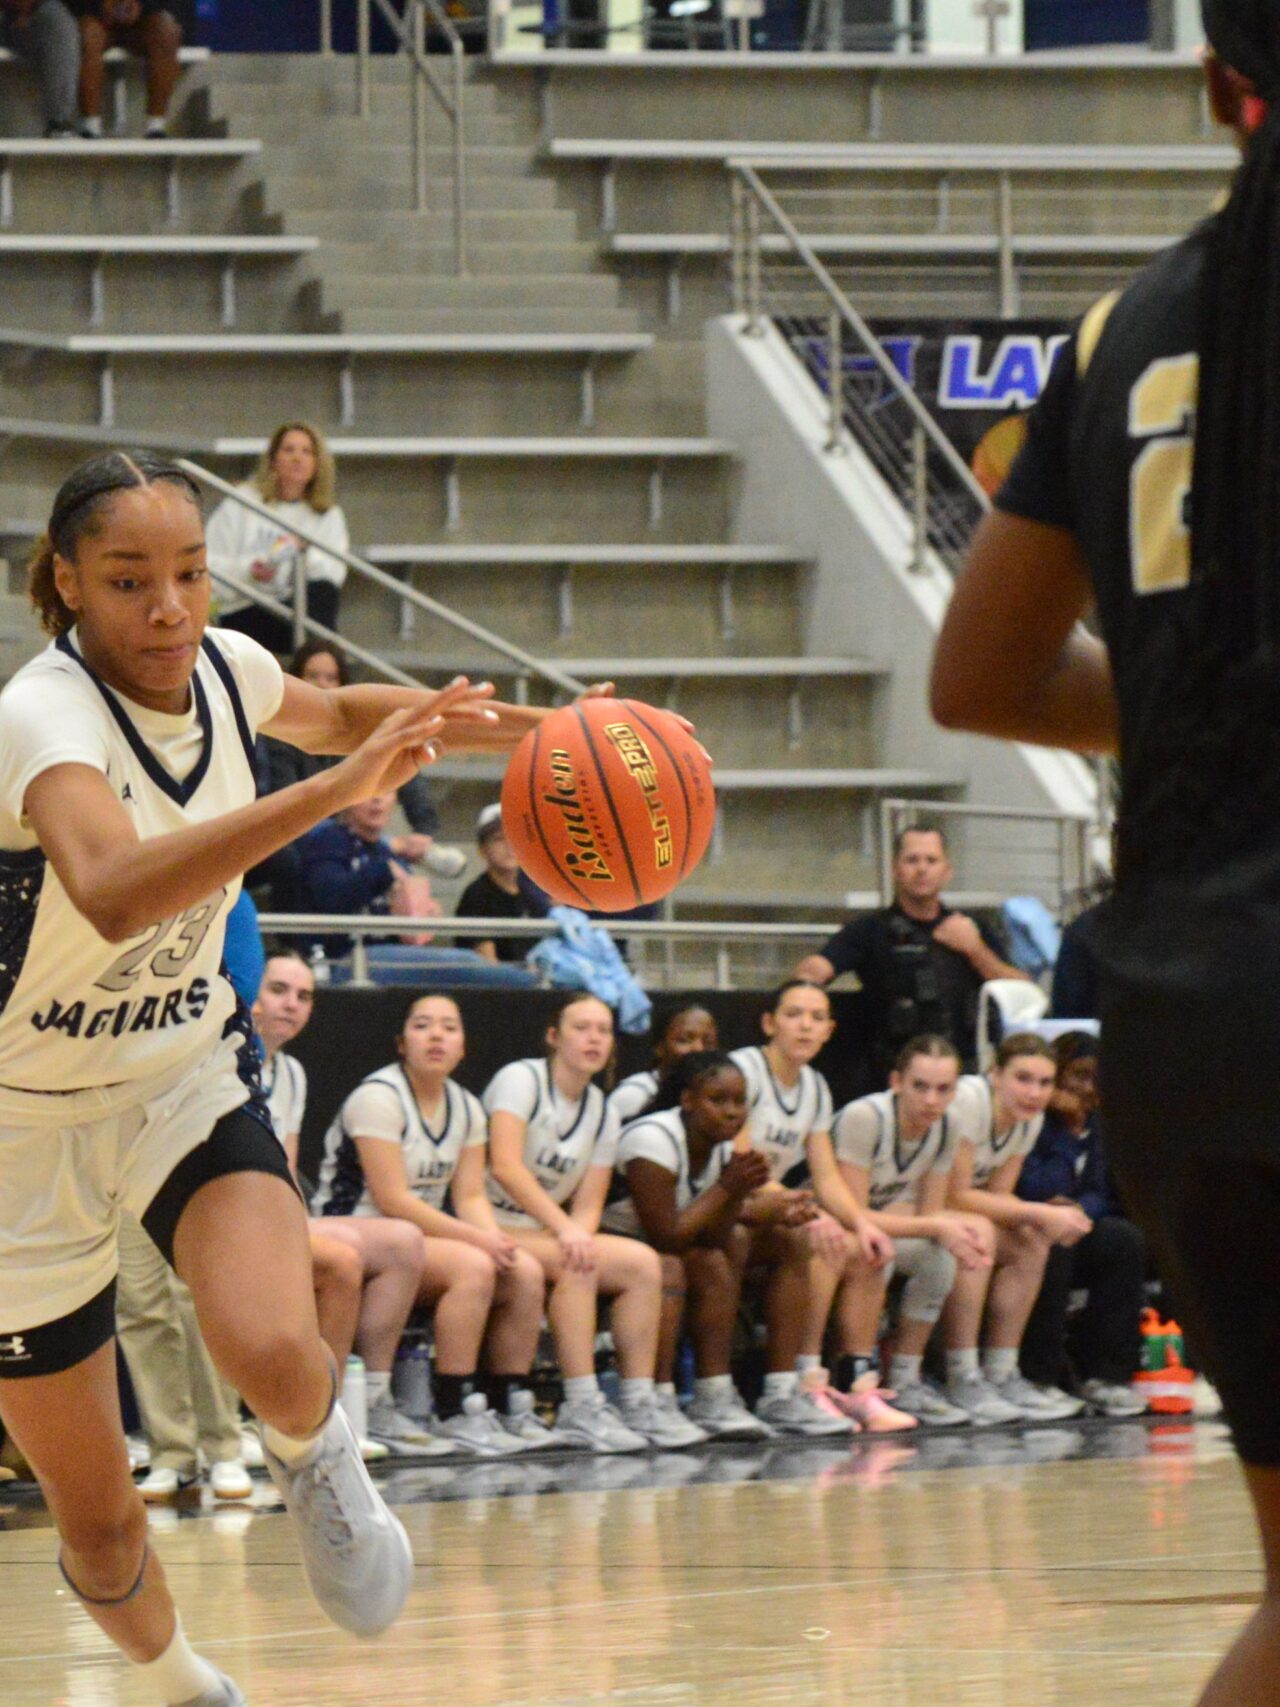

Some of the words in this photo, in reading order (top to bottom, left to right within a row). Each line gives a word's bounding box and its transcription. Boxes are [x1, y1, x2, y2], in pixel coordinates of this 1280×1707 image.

[938, 335, 1071, 408] LA
[543, 749, 615, 882] Baden
[92, 886, 228, 992] 23
[30, 977, 210, 1039] JAGUARS
